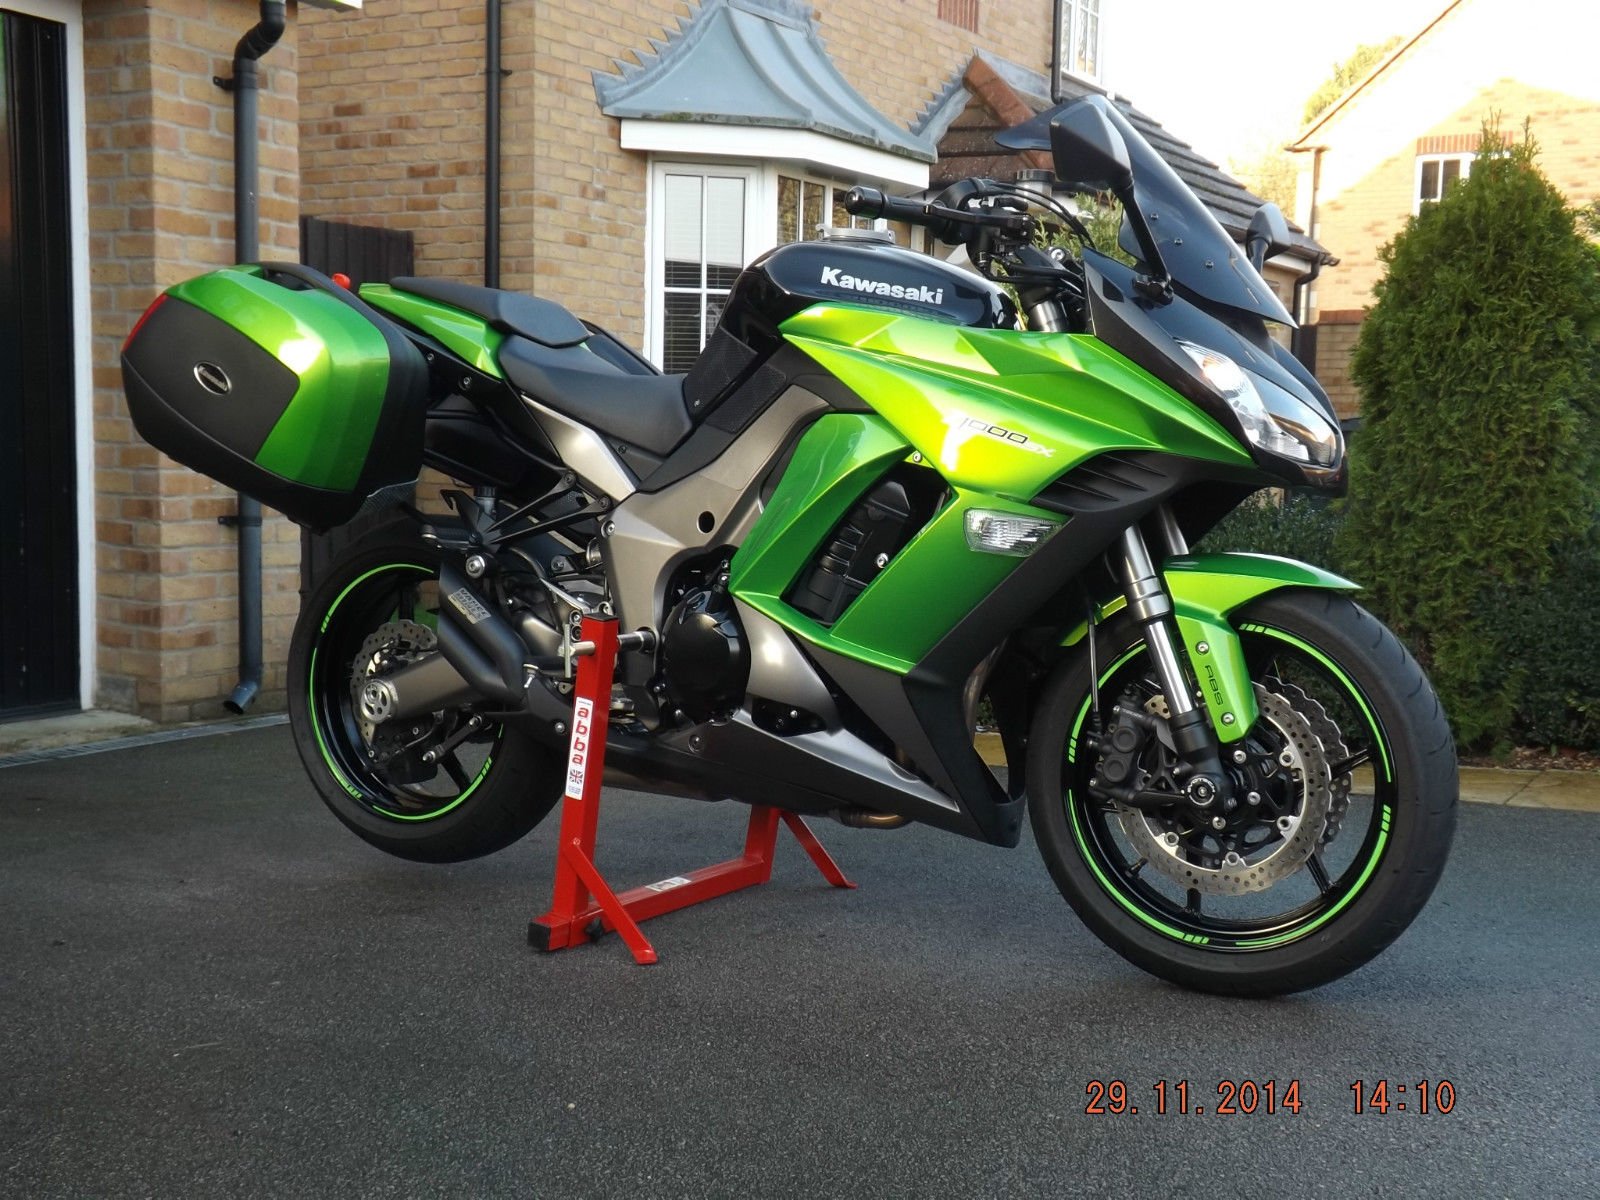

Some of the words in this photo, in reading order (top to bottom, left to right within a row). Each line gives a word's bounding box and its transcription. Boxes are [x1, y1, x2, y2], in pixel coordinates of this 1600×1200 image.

[820, 266, 944, 305] Kawasaki
[1204, 664, 1224, 706] ABS
[571, 707, 590, 766] abba
